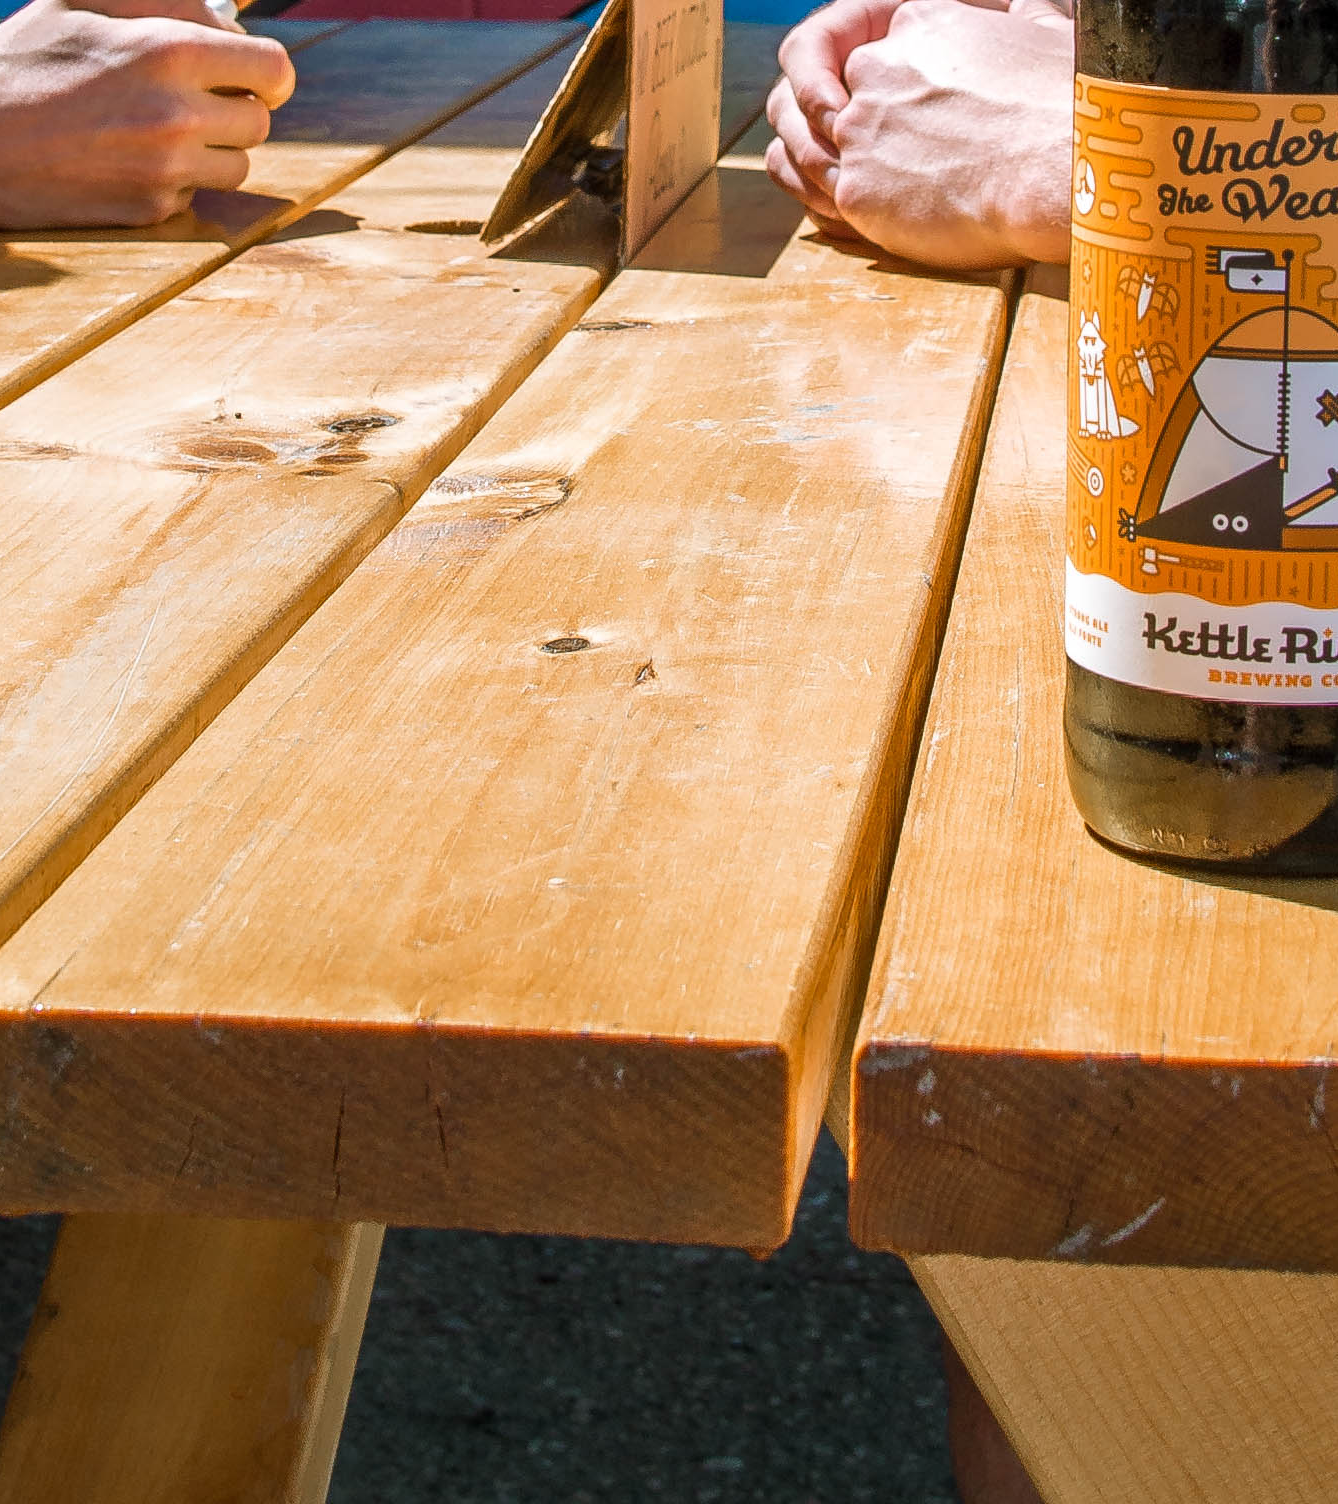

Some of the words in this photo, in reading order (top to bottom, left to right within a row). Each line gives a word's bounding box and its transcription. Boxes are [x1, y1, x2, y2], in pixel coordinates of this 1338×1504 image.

[1157, 183, 1213, 217] The
[1142, 612, 1272, 663] Kettle
[1207, 668, 1313, 688] BREWING
